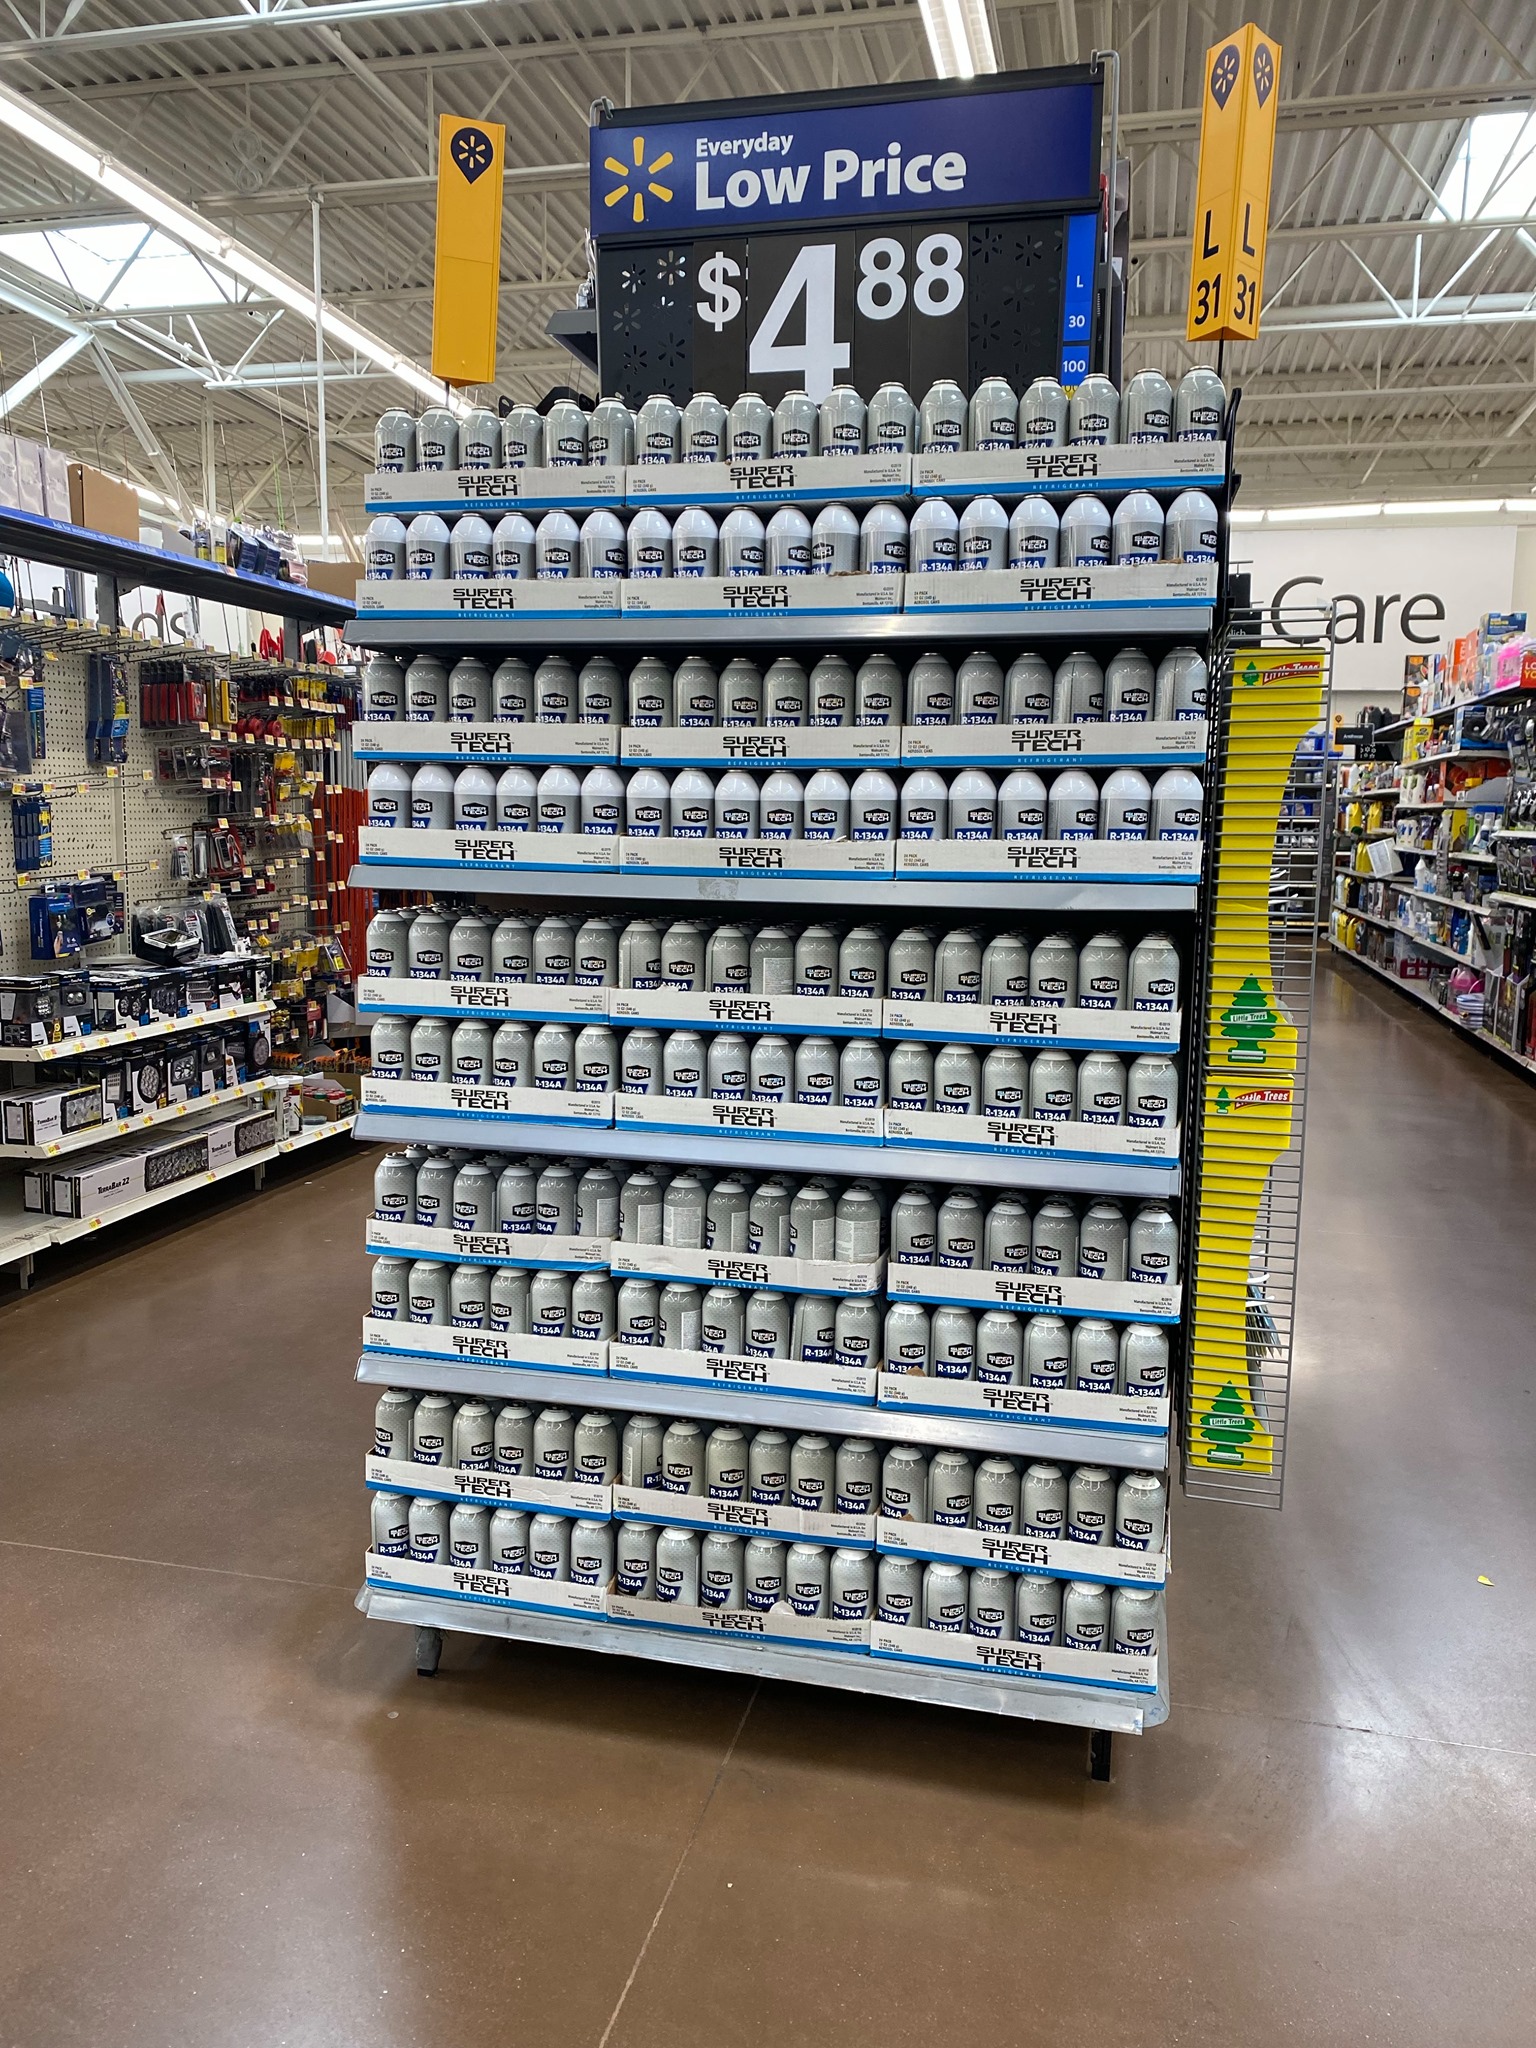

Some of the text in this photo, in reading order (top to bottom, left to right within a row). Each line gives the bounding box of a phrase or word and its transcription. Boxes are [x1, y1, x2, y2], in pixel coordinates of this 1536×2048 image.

[696, 132, 793, 159] Everyday
[696, 142, 967, 211] Low Price
[1203, 210, 1219, 260] L
[1242, 202, 1255, 258] L
[1076, 275, 1084, 288] L
[1194, 273, 1221, 325] 31
[1233, 273, 1256, 325] 31
[1069, 315, 1085, 328] 30
[1063, 360, 1086, 372] 100
[1026, 453, 1097, 465] SUPER
[730, 465, 793, 476] SUPER
[1027, 463, 1097, 478] TECH
[458, 475, 517, 484] SUPER
[730, 475, 794, 489] TECH
[458, 483, 518, 497] TECH
[1020, 577, 1091, 588] SUPER
[453, 588, 512, 597] SUPER
[723, 586, 787, 595] SUPER
[1020, 586, 1091, 601] TECH
[453, 596, 514, 609] TECH
[723, 593, 788, 608] TECH
[1271, 576, 1446, 645] Care
[451, 732, 510, 740] SUPER
[723, 736, 786, 745] SUPER
[1011, 730, 1081, 739] SUPER
[451, 739, 511, 752] TECH
[724, 743, 786, 757] TECH
[1012, 737, 1081, 752] TECH
[956, 830, 988, 840] R-134A
[1109, 831, 1142, 840] R-134A
[1161, 831, 1194, 840] R-134A
[455, 840, 513, 848] SUPER
[455, 846, 514, 860] TECH
[719, 847, 782, 856] SUPER
[1007, 847, 1076, 855] SUPER
[720, 853, 783, 868] TECH
[1008, 853, 1077, 868] TECH
[451, 986, 508, 995] SUPER
[451, 993, 509, 1007] TECH
[947, 993, 978, 1002] R-134A
[1081, 998, 1112, 1008] R-134A
[710, 1000, 770, 1009] SUPER
[1136, 1000, 1170, 1011] R-134A
[710, 1006, 771, 1021] TECH
[990, 1012, 1056, 1022] SUPER
[1232, 1014, 1249, 1022] Little
[990, 1019, 1057, 1035] TECH
[451, 1089, 508, 1099] SUPER
[713, 1091, 742, 1100] R-134A
[1236, 1090, 1288, 1107] Little Trees
[451, 1095, 509, 1110] TECH
[892, 1099, 922, 1109] R-134A
[713, 1105, 773, 1116] SUPER
[986, 1107, 1017, 1117] R-134A
[1035, 1110, 1066, 1119] R-134A
[713, 1112, 775, 1127] TECH
[1084, 1113, 1114, 1123] R-134A
[988, 1122, 1054, 1133] SUPER
[988, 1130, 1054, 1146] TECH
[122, 1177, 129, 1186] 22
[504, 1222, 531, 1231] R-134A
[453, 1234, 509, 1245] SUPER
[454, 1241, 510, 1255] TECH
[708, 1259, 768, 1270] SUPER
[900, 1254, 930, 1264] R-134A
[940, 1257, 968, 1267] R-134A
[708, 1266, 768, 1282] TECH
[995, 1281, 1062, 1293] SUPER
[996, 1288, 1062, 1305] TECH
[1000, 1305, 1062, 1314] REFRIGERANT
[453, 1336, 508, 1348] SUPER
[453, 1344, 508, 1358] TECH
[706, 1359, 766, 1369] SUPER
[938, 1364, 968, 1374] R-134A
[707, 1366, 767, 1382] TECH
[713, 1382, 768, 1392] REFRIGERANT
[1032, 1377, 1063, 1388] R-134A
[1079, 1382, 1110, 1392] R-134A
[983, 1388, 1049, 1401] SUPER
[1128, 1387, 1161, 1397] R-134A
[983, 1396, 1050, 1413] TECH
[990, 1413, 1050, 1423] REFRIGERANT
[454, 1475, 510, 1487] SUPER
[454, 1482, 512, 1498] TECH
[710, 1488, 738, 1498] R-134A
[708, 1503, 768, 1516] SUPER
[708, 1511, 769, 1527] TECH
[936, 1514, 966, 1525] R-134A
[713, 1525, 770, 1535] REFRIGERANT
[982, 1538, 1048, 1553] SUPER
[982, 1547, 1048, 1565] TECH
[989, 1562, 1049, 1574] REFRIGERANT
[453, 1572, 508, 1585] SUPER
[454, 1580, 510, 1596] TECH
[702, 1612, 762, 1622] SUPER
[834, 1607, 862, 1618] R-134A
[702, 1617, 764, 1631] TECH
[930, 1621, 959, 1632] R-134A
[977, 1646, 1042, 1660] SUPER
[977, 1654, 1042, 1671] TECH
